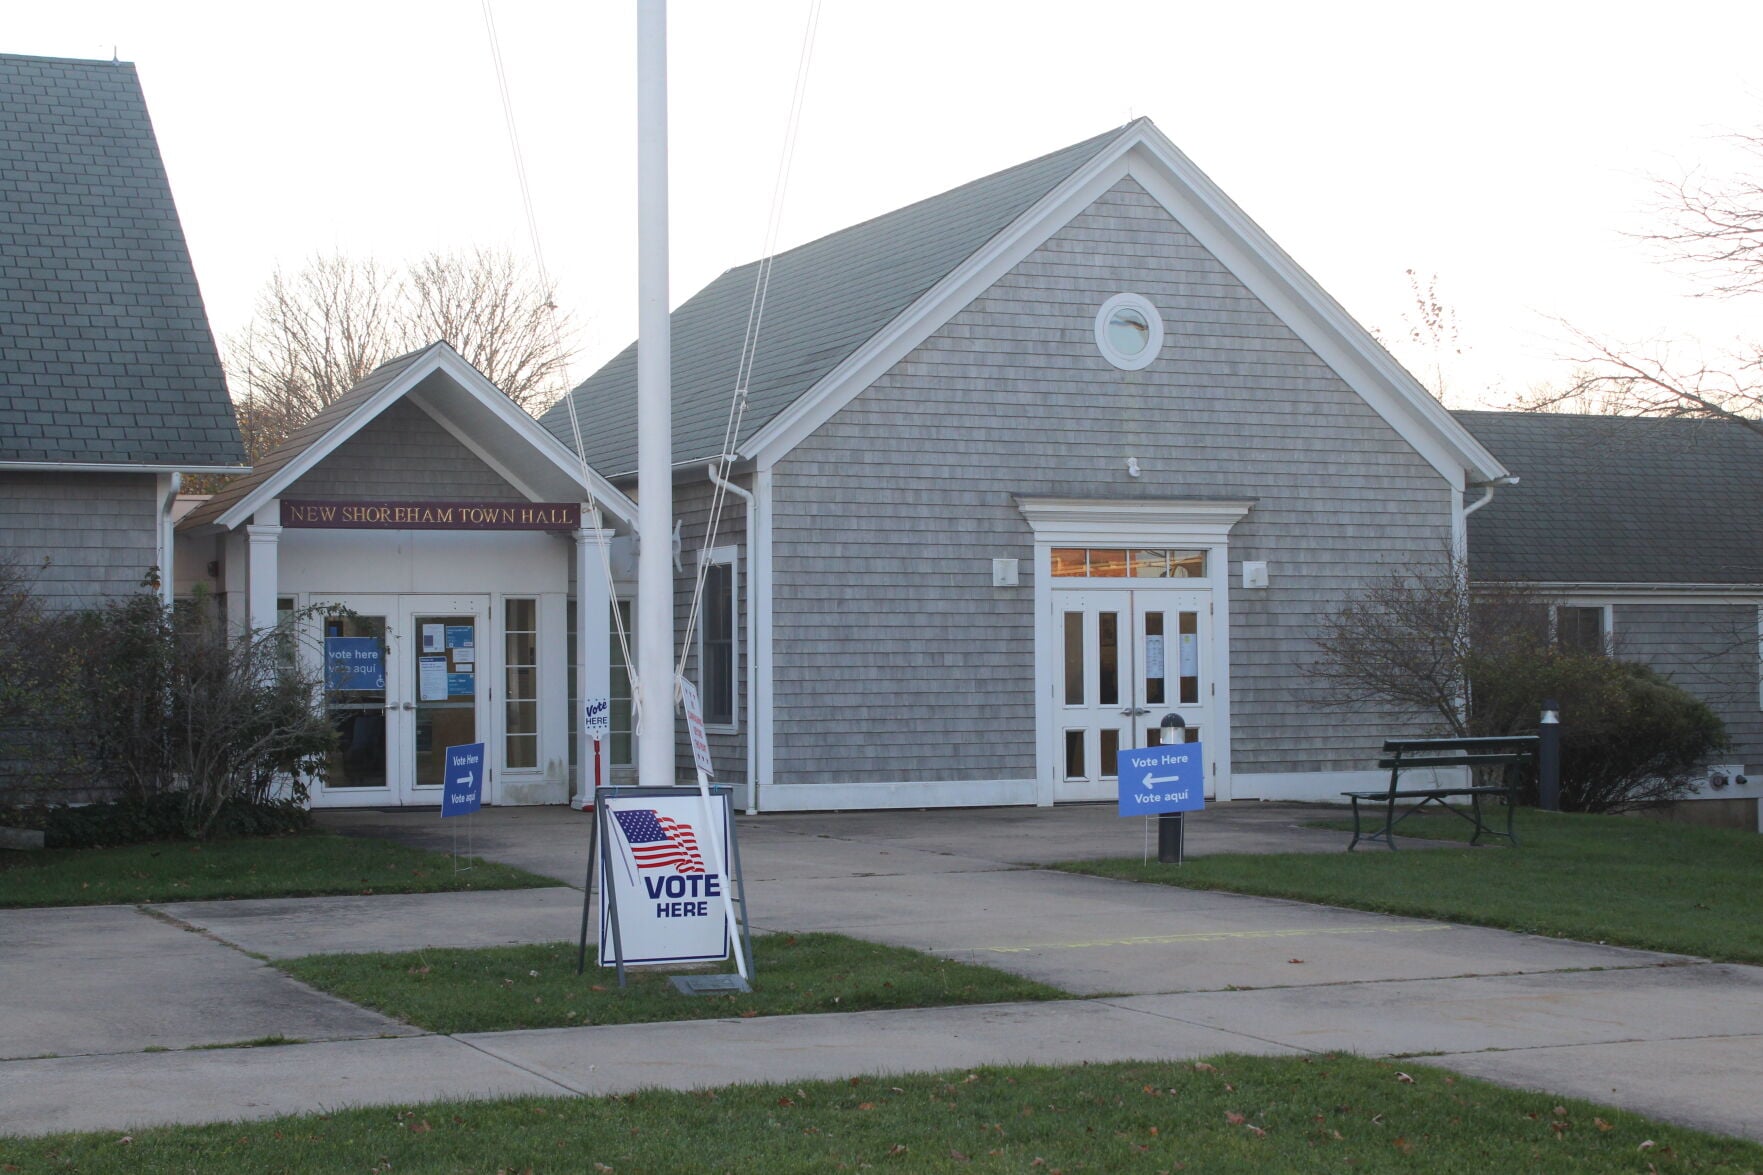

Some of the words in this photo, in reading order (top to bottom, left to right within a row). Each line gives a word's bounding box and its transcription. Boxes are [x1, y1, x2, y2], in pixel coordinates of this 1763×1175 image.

[290, 506, 336, 521] NEW
[342, 507, 453, 523] SHOREHAM
[459, 508, 515, 524] TOWN
[521, 509, 573, 524] HALL
[328, 650, 351, 659] vote
[355, 649, 378, 659] here
[585, 701, 608, 718] Vote
[585, 716, 608, 726] HERE
[453, 755, 466, 766] Vote
[466, 754, 479, 765] Here
[1131, 757, 1158, 768] Vote
[1161, 754, 1189, 765] Here
[451, 793, 465, 805] Vote
[1134, 793, 1161, 805] Vote
[1164, 789, 1189, 803] aquí
[644, 874, 721, 899] VOTE
[656, 901, 708, 918] HERE
